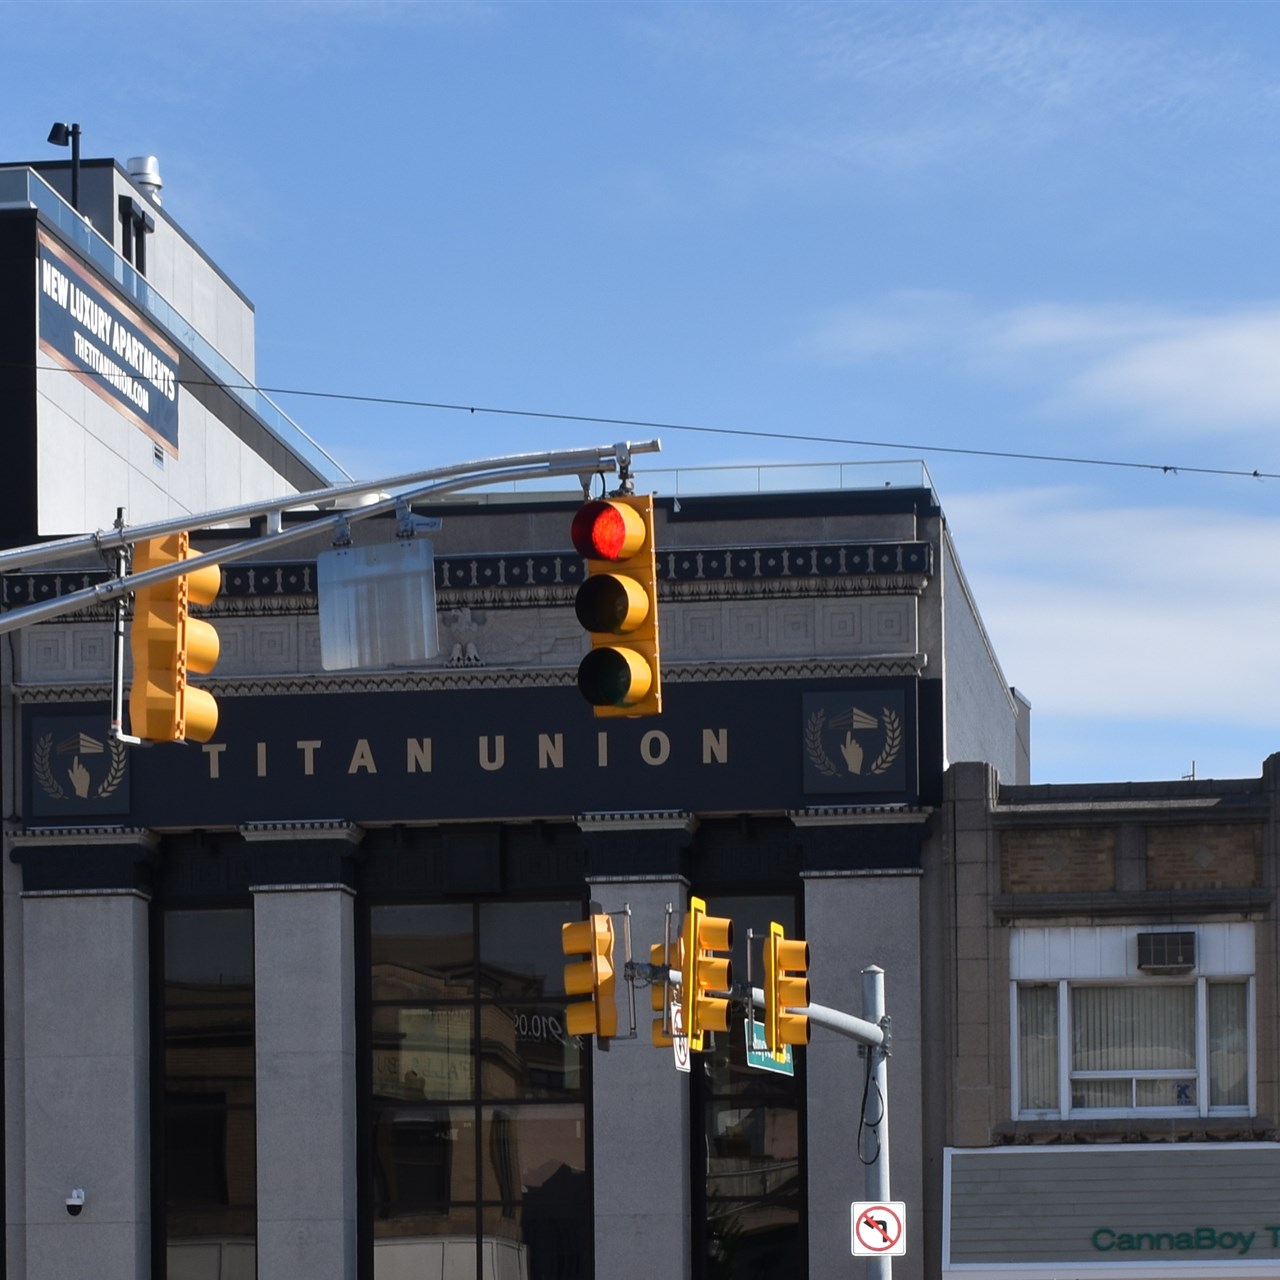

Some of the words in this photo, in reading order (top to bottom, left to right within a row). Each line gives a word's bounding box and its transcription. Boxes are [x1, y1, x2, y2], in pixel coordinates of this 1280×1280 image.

[42, 258, 68, 309] NEW
[69, 282, 113, 345] LUXURY
[112, 321, 175, 401] APARTMENTS
[73, 331, 149, 413] THETITANUNION.COM
[202, 736, 434, 780] TITAN
[477, 727, 730, 773] UNION
[1091, 1226, 1256, 1254] CannaBoy
